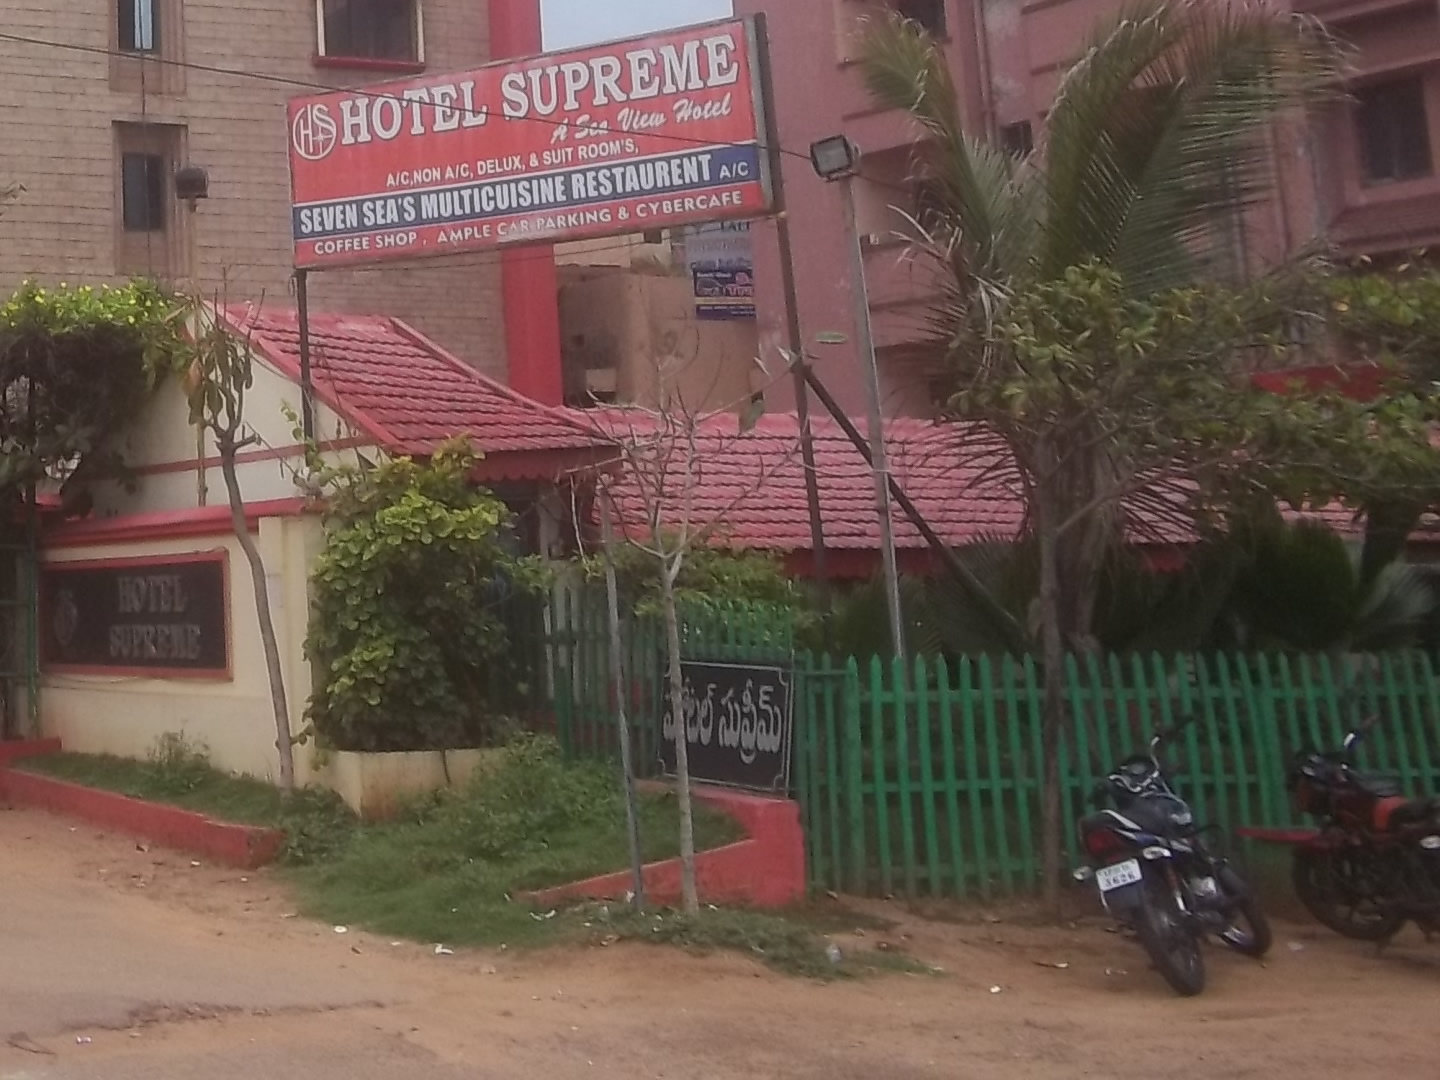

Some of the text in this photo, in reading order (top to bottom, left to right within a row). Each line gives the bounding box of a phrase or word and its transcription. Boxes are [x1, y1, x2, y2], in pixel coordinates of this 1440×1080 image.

[339, 33, 741, 146] HOTEL SUPREME
[550, 92, 732, 144] A Sea View Hotel
[444, 162, 475, 180] A/C,
[477, 155, 527, 175] DELUX,
[529, 153, 539, 168] &
[542, 148, 574, 166] SUIT
[577, 137, 639, 160] ROOM'S,
[299, 153, 750, 235] SEVEN SEA'S MULTICUISINE RESTAURENT A/C
[314, 237, 371, 256] COFFEE
[437, 223, 492, 245] AMPLE
[496, 220, 531, 237] CAR
[535, 208, 612, 231] PARKING
[617, 206, 630, 221] &
[636, 190, 743, 217] CYBERCAFE
[117, 574, 188, 614] HOTEL
[110, 622, 202, 660] SUPREME
